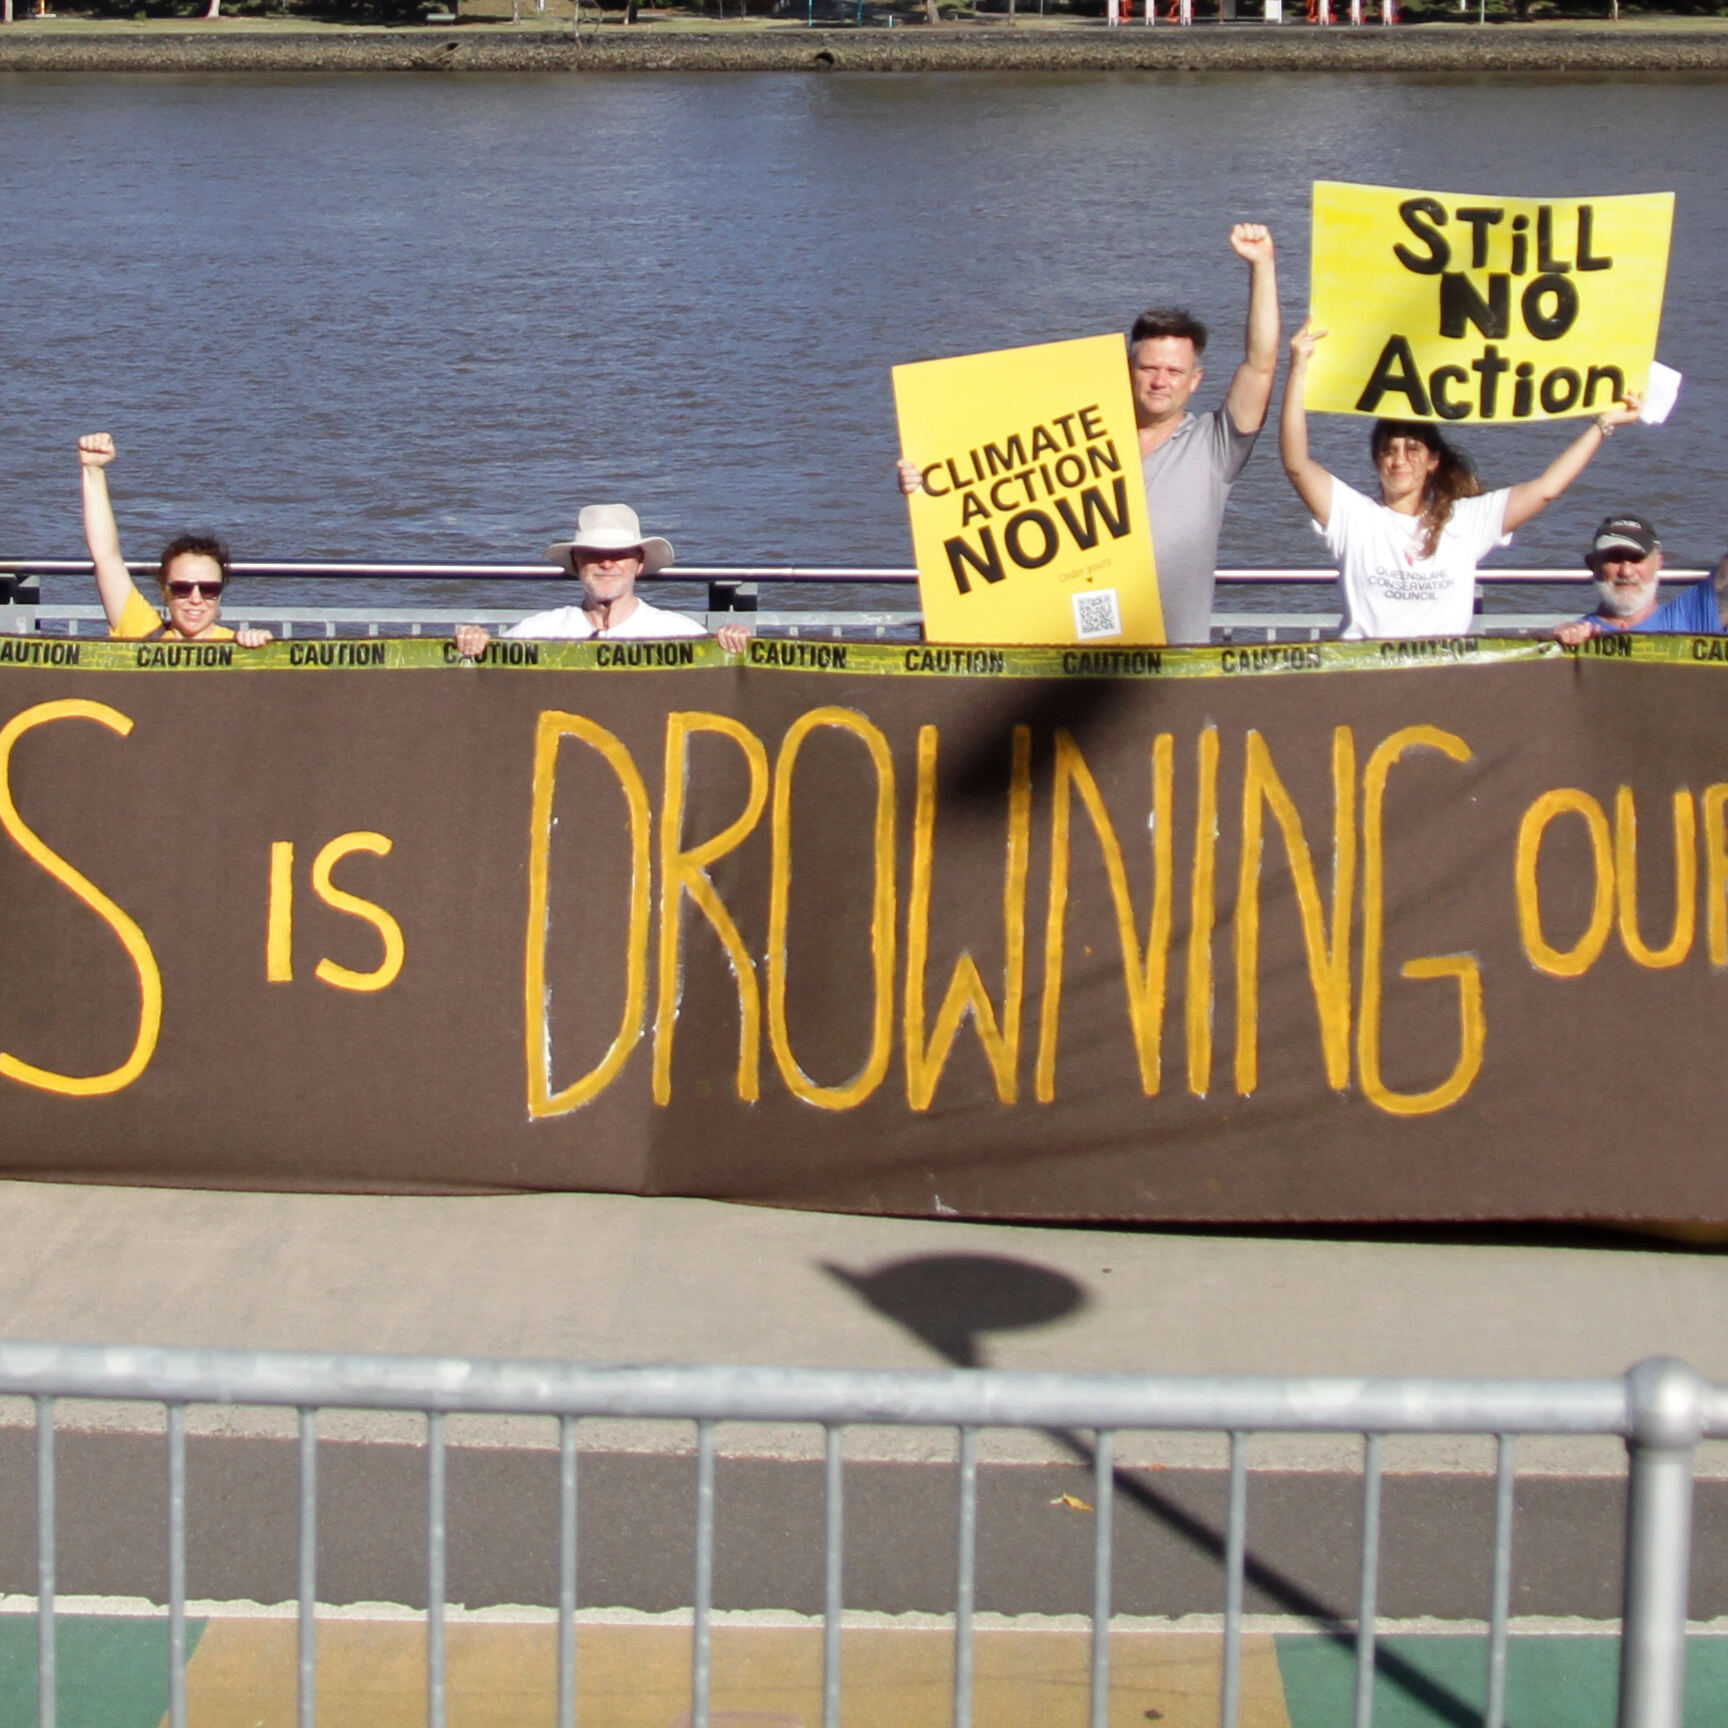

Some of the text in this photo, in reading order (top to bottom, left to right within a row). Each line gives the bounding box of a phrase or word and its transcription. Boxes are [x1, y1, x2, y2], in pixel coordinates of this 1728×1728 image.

[1439, 272, 1578, 340] NO
[1356, 335, 1625, 419] Action
[921, 404, 1108, 497] CLIMATE
[962, 439, 1122, 526] ACTION
[944, 476, 1131, 595] NOW
[1384, 589, 1438, 600] COUNCIL
[137, 645, 233, 668] CAUTION
[289, 644, 385, 665] CAUTION
[443, 643, 538, 665] CUTION
[597, 642, 694, 666] CAUTION
[751, 641, 847, 669] CAUTION
[905, 648, 1004, 673] CAUTION
[1062, 650, 1162, 674] CAUTION
[1221, 647, 1322, 673] CAUTION
[267, 830, 405, 992] IS
[525, 705, 1487, 1119] DROWNING
